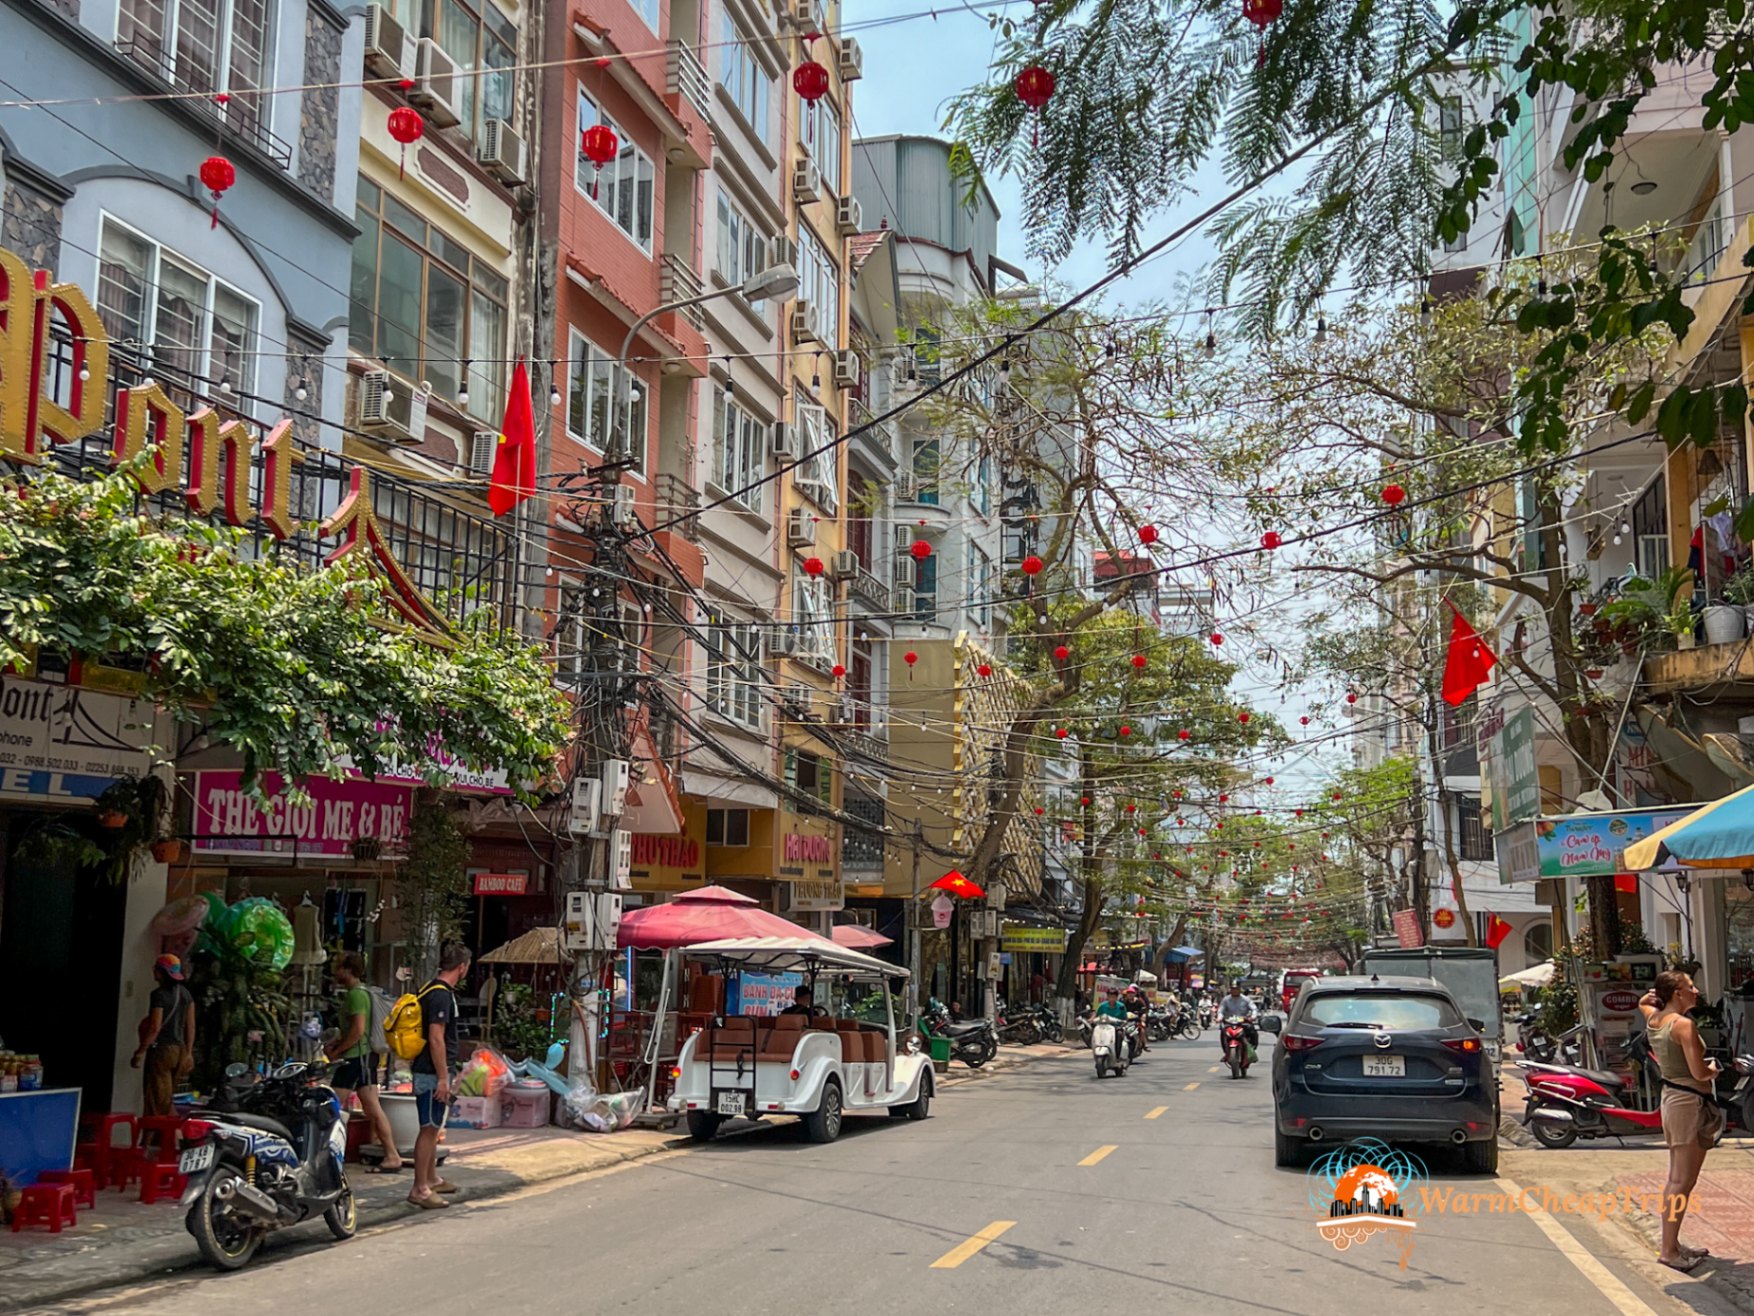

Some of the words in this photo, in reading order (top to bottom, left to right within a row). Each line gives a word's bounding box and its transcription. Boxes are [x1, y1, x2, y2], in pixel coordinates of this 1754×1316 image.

[469, 775, 484, 787] CHO
[1606, 994, 1638, 1004] COMBO
[1375, 1056, 1393, 1065] 30G
[1367, 1066, 1401, 1075] 791.72
